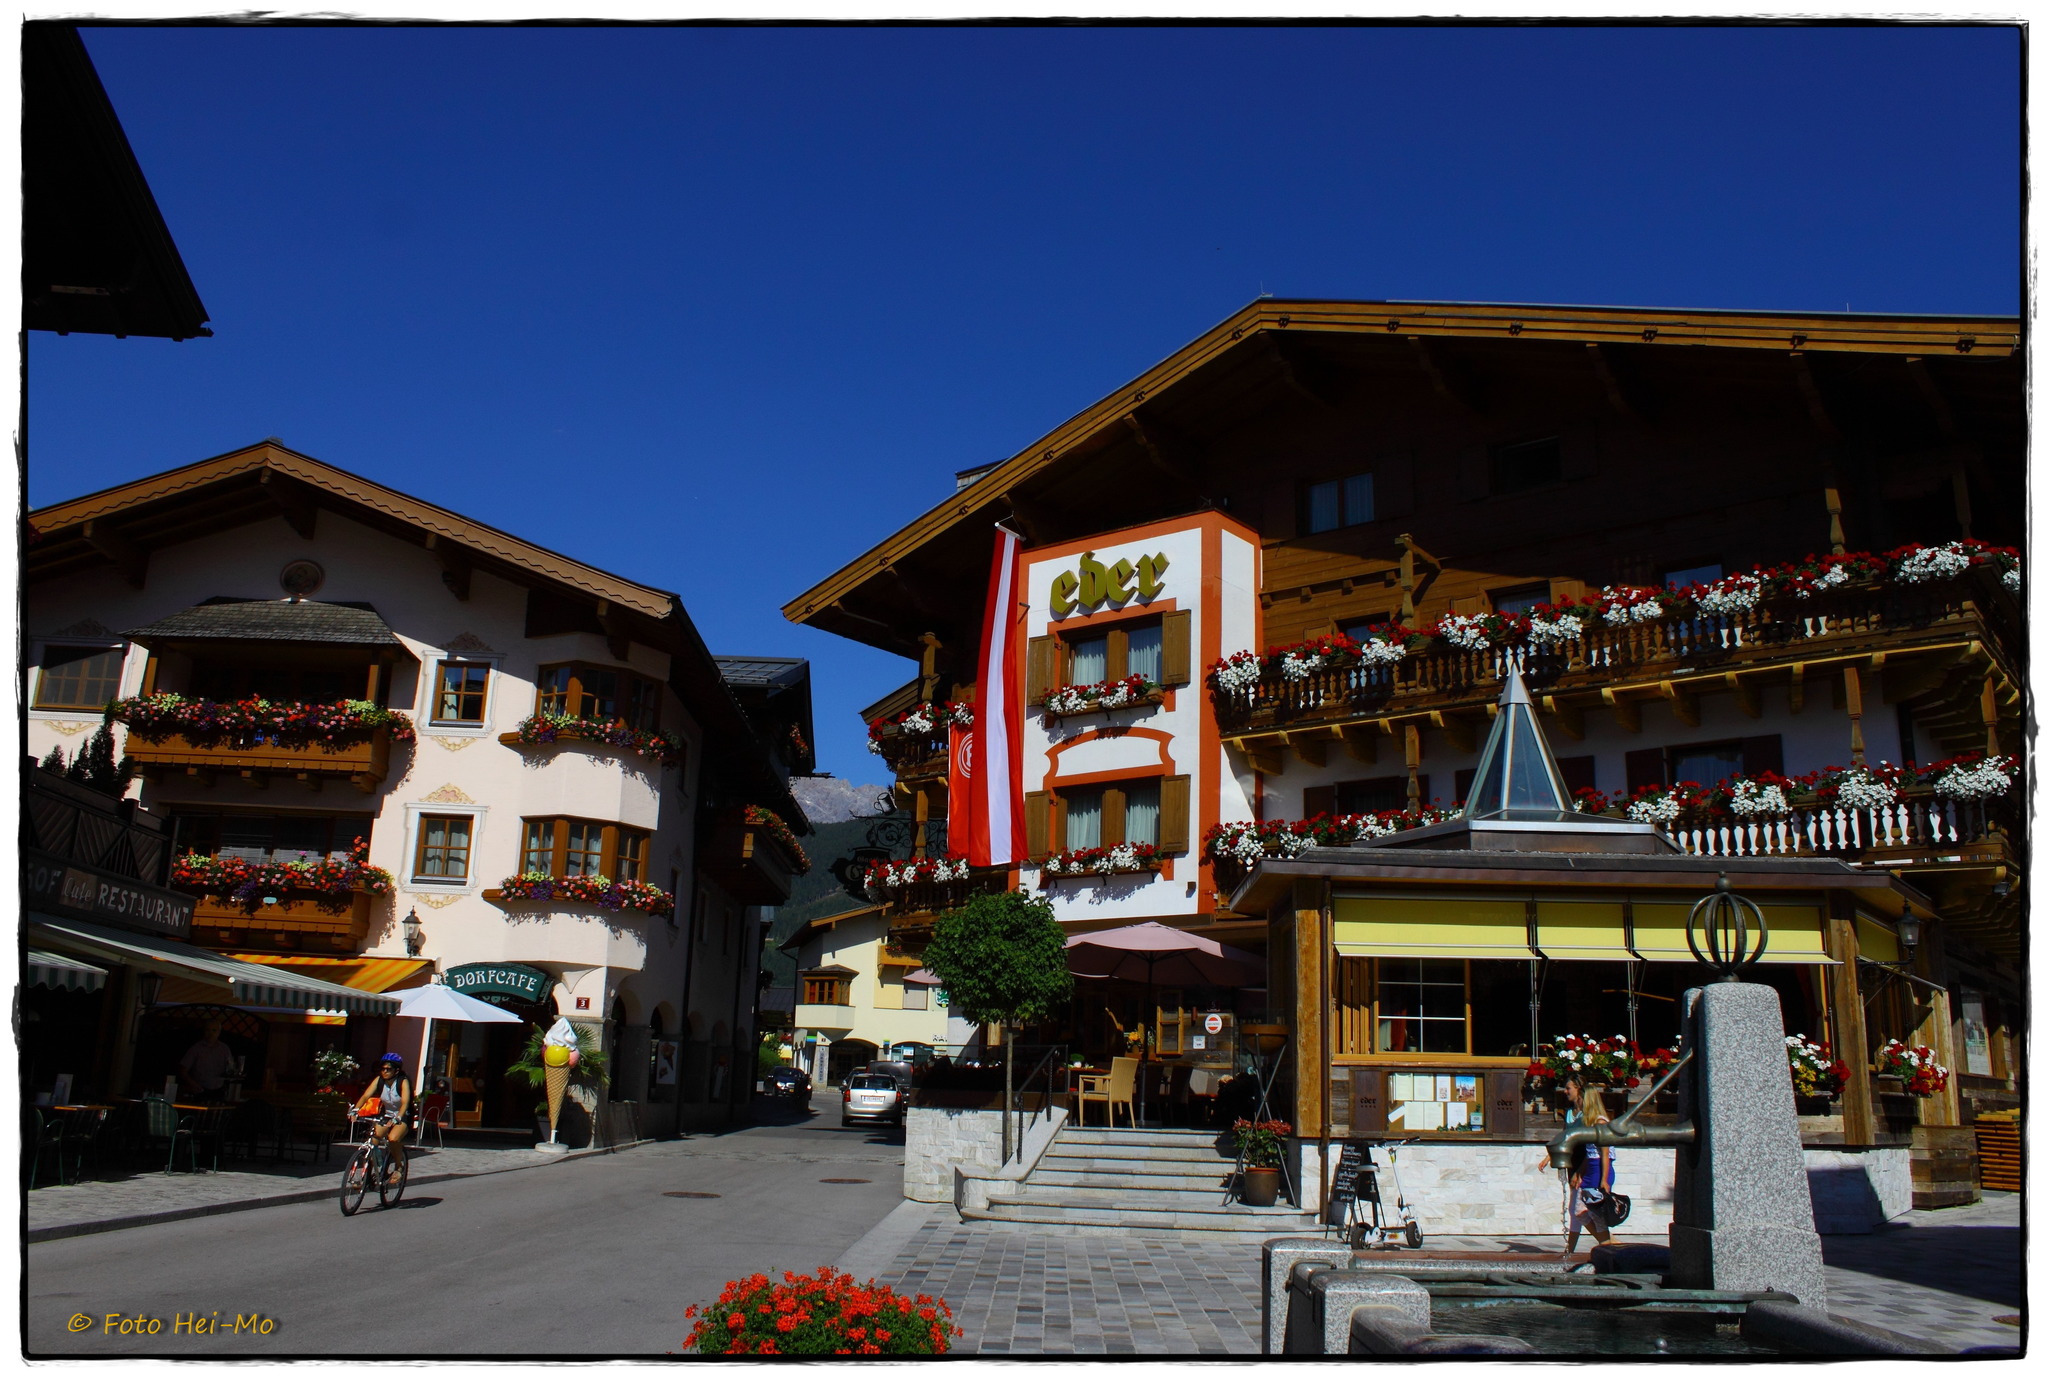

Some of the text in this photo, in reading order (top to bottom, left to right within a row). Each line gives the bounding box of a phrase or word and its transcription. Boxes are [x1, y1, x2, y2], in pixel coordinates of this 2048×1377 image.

[1050, 551, 1170, 615] eder
[98, 883, 190, 927] RESTAURANT
[453, 969, 538, 992] DORFCAFE
